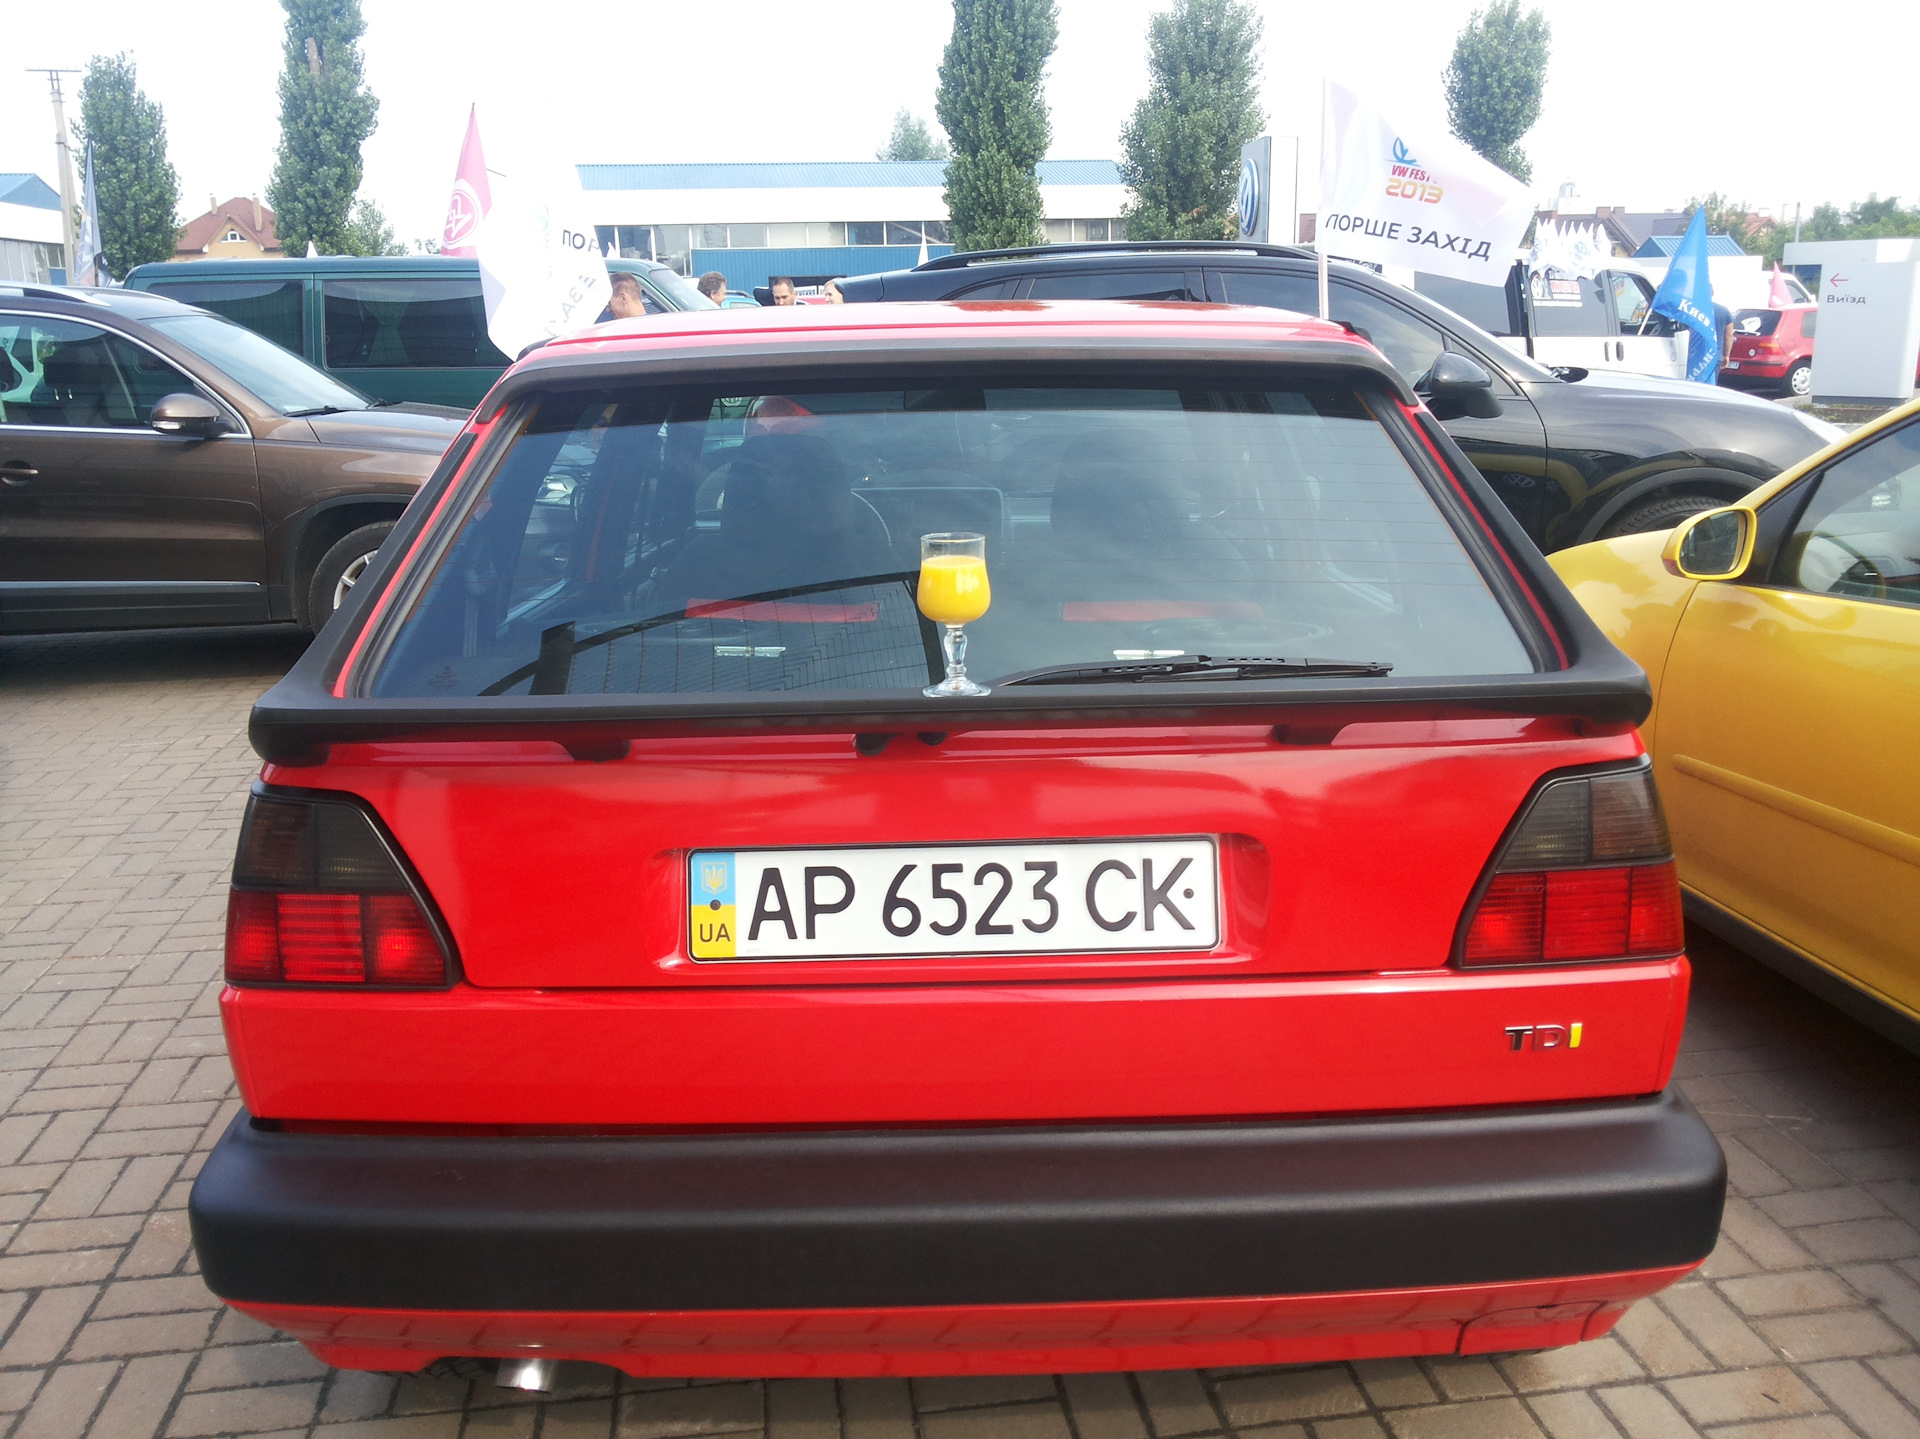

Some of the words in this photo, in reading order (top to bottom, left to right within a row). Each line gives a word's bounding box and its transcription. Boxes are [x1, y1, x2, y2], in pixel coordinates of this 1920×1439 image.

[1391, 164, 1409, 178] VW
[1385, 177, 1444, 204] 2013
[1407, 226, 1492, 262] ЗАХІД
[1826, 294, 1866, 304] Виїзд
[748, 866, 856, 940] AP
[882, 861, 1059, 937] 6523
[1086, 858, 1196, 932] CK
[699, 923, 732, 943] UA
[1504, 1022, 1583, 1052] TDI
